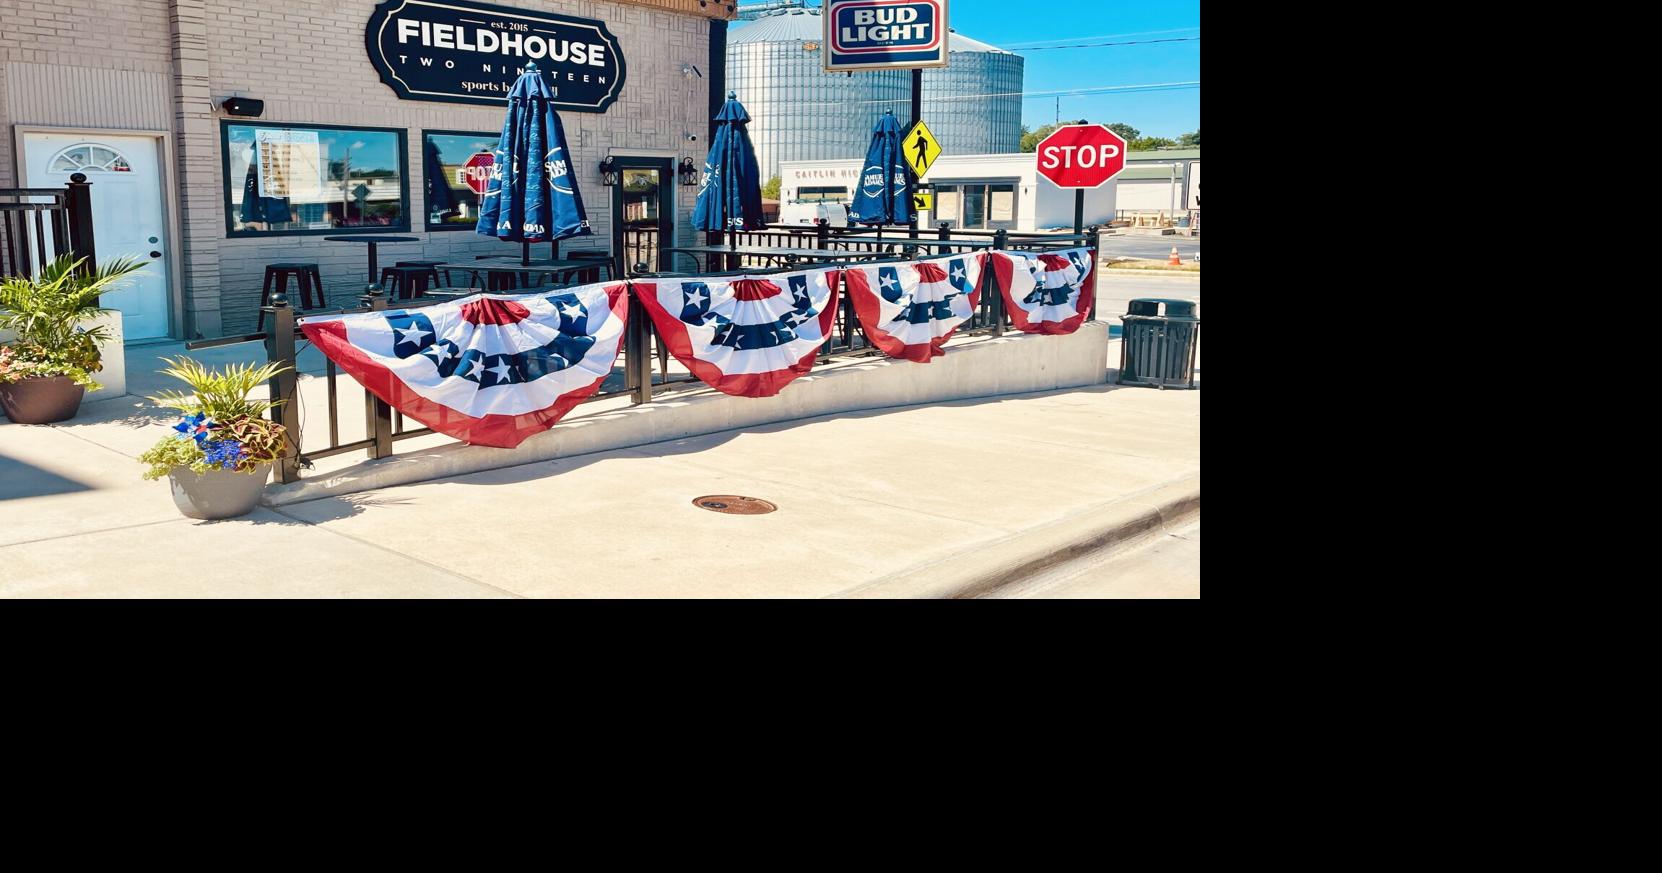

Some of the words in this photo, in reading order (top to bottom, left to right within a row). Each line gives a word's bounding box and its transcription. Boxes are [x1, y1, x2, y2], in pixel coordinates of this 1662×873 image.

[854, 7, 918, 26] BUD
[490, 21, 507, 30] est.
[509, 22, 529, 32] 2015
[842, 23, 930, 42] LIGHT
[397, 18, 605, 67] FIELDHOUSE
[399, 54, 455, 69] TWO
[461, 80, 499, 92] sports
[1042, 144, 1120, 169] STOP
